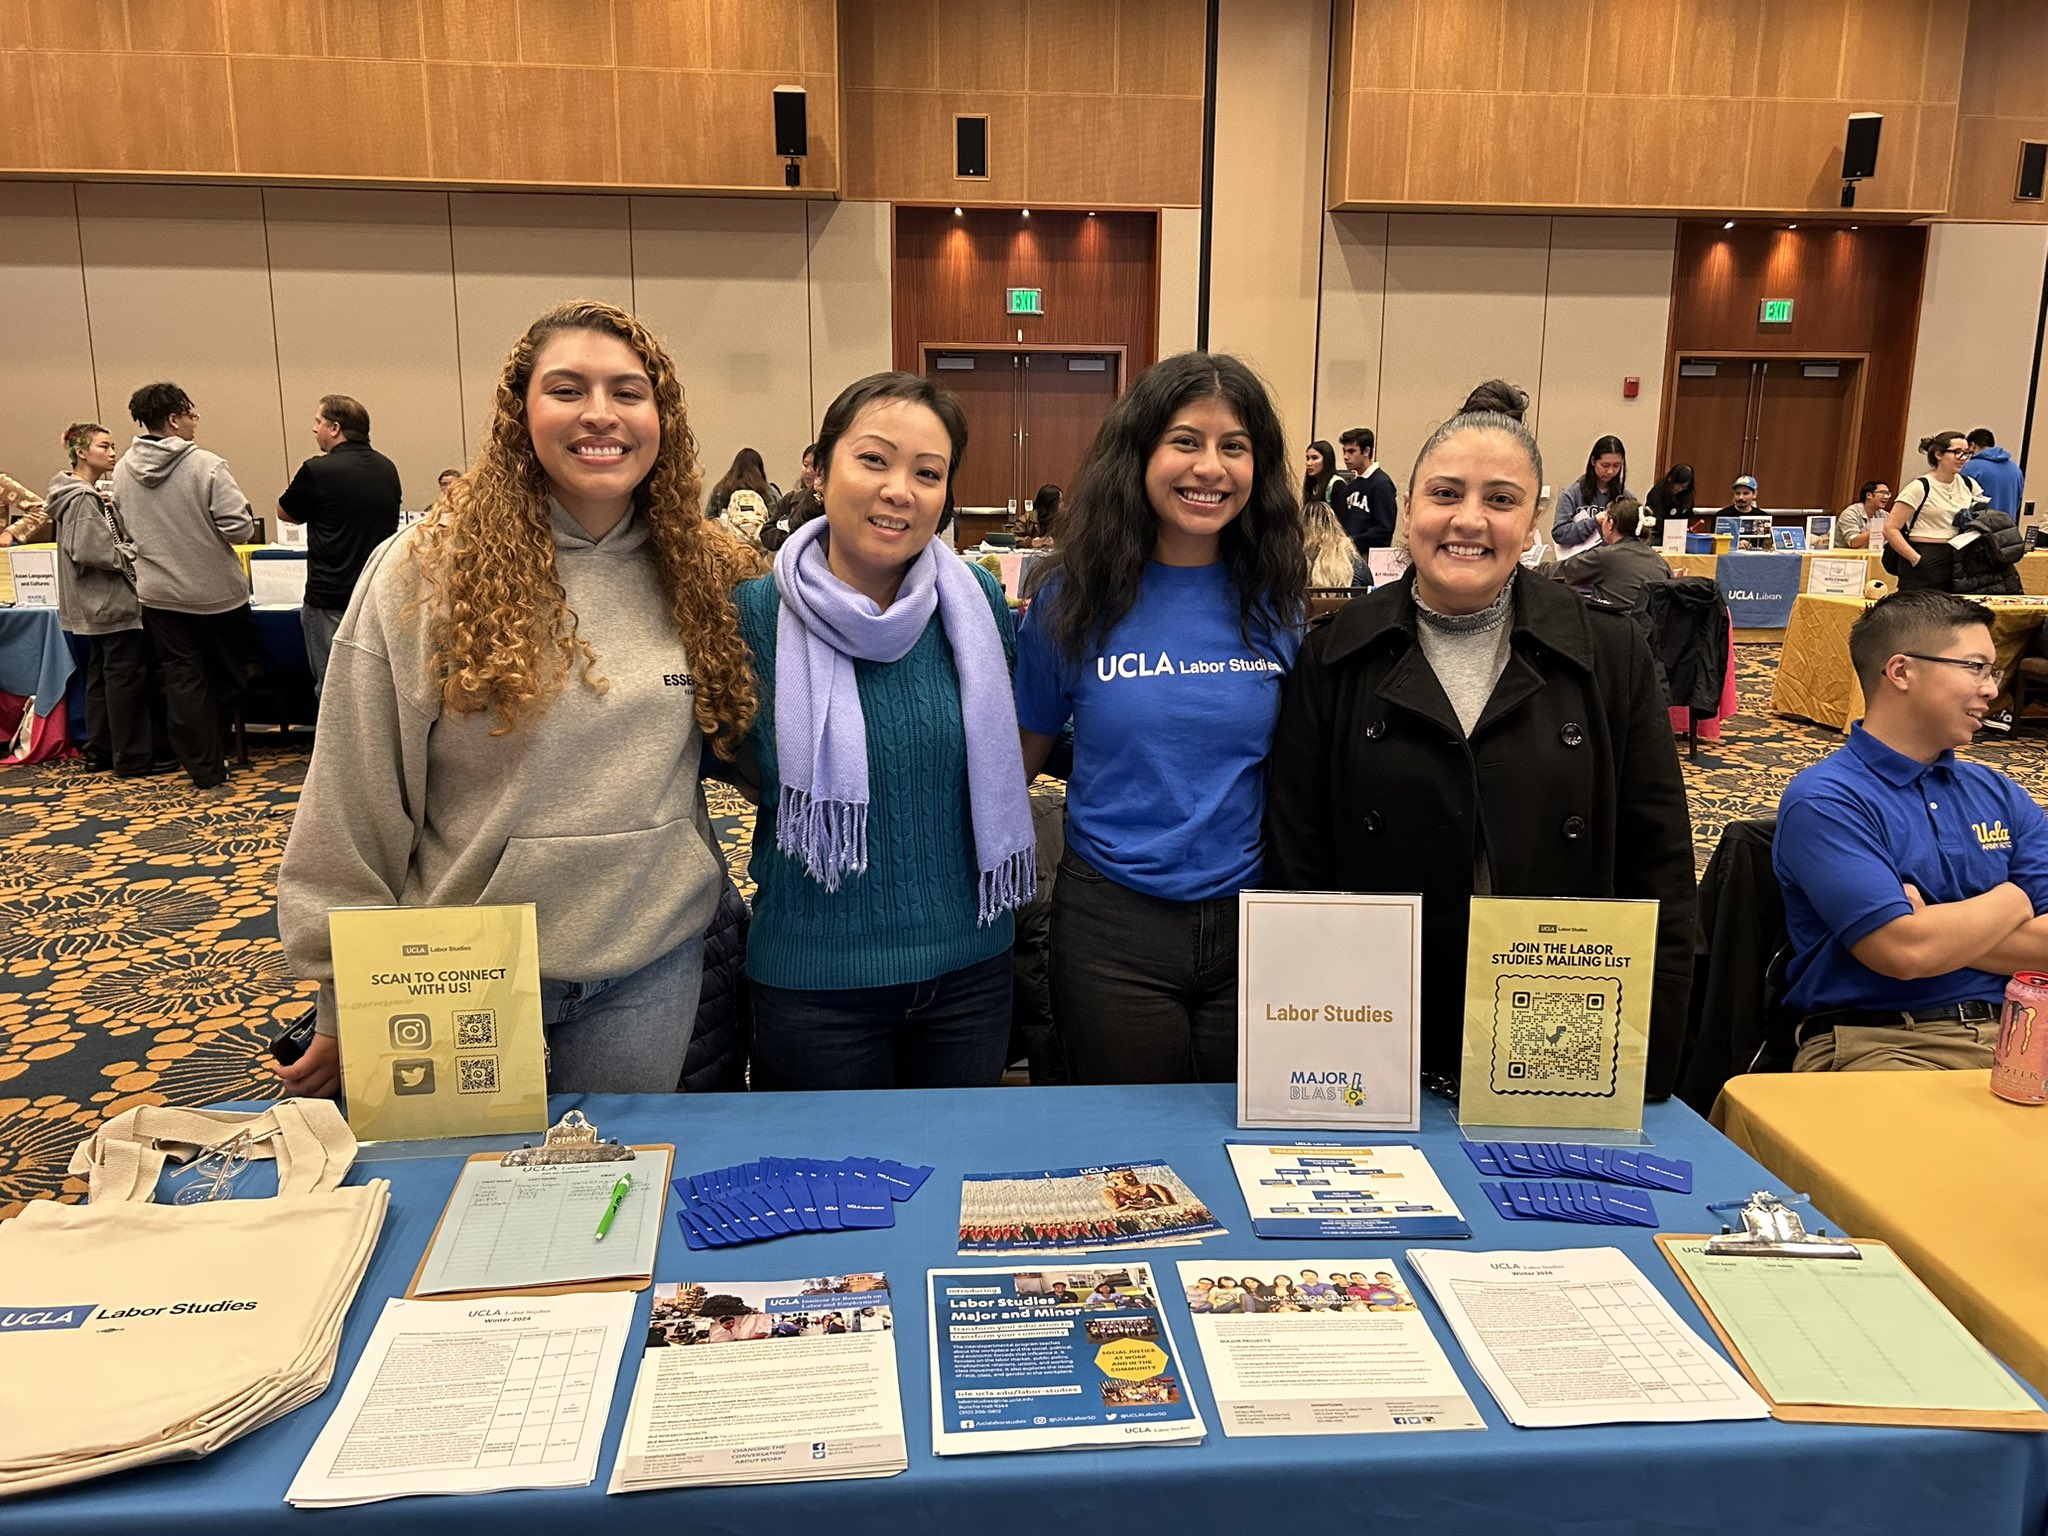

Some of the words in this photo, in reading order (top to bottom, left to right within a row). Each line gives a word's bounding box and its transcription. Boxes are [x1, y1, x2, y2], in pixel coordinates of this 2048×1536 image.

[1012, 290, 1038, 311] EXIT
[1766, 301, 1791, 321] EXIT
[1728, 590, 1754, 600] UCLA
[1755, 590, 1782, 602] Library
[1097, 651, 1175, 682] UCLA
[1180, 660, 1226, 674] Labor
[405, 946, 426, 954] UCLA
[1509, 942, 1540, 954] JOIN
[1543, 943, 1567, 954] THE
[1570, 944, 1614, 956] LABOR
[1492, 954, 1544, 966] STUDIES
[1546, 955, 1602, 968] MAILING
[1605, 957, 1632, 968] LIST
[371, 972, 412, 986] SCAN
[414, 972, 435, 984] TO
[438, 969, 506, 982] CONNECT
[408, 984, 445, 996] WITH
[448, 982, 472, 994] US!
[1266, 1003, 1320, 1022] Labor
[1324, 1004, 1394, 1023] Studies
[1290, 1071, 1348, 1085] MAJOR
[1290, 1086, 1348, 1100] BLAST
[1080, 1166, 1110, 1175] UCLA
[1490, 1262, 1521, 1270] UCLA
[770, 1298, 800, 1306] UCLA
[950, 1299, 995, 1308] Labor
[998, 1296, 1056, 1307] Studies
[1, 1310, 72, 1328] UCLA
[96, 1307, 168, 1320] Labor
[169, 1300, 258, 1315] Studies
[468, 1309, 501, 1317] UCLA
[951, 1311, 998, 1322] Major
[1001, 1309, 1031, 1319] and
[1034, 1308, 1082, 1318] Minor
[731, 1450, 787, 1459] CONVERSATION
[732, 1445, 772, 1453] CHANGING
